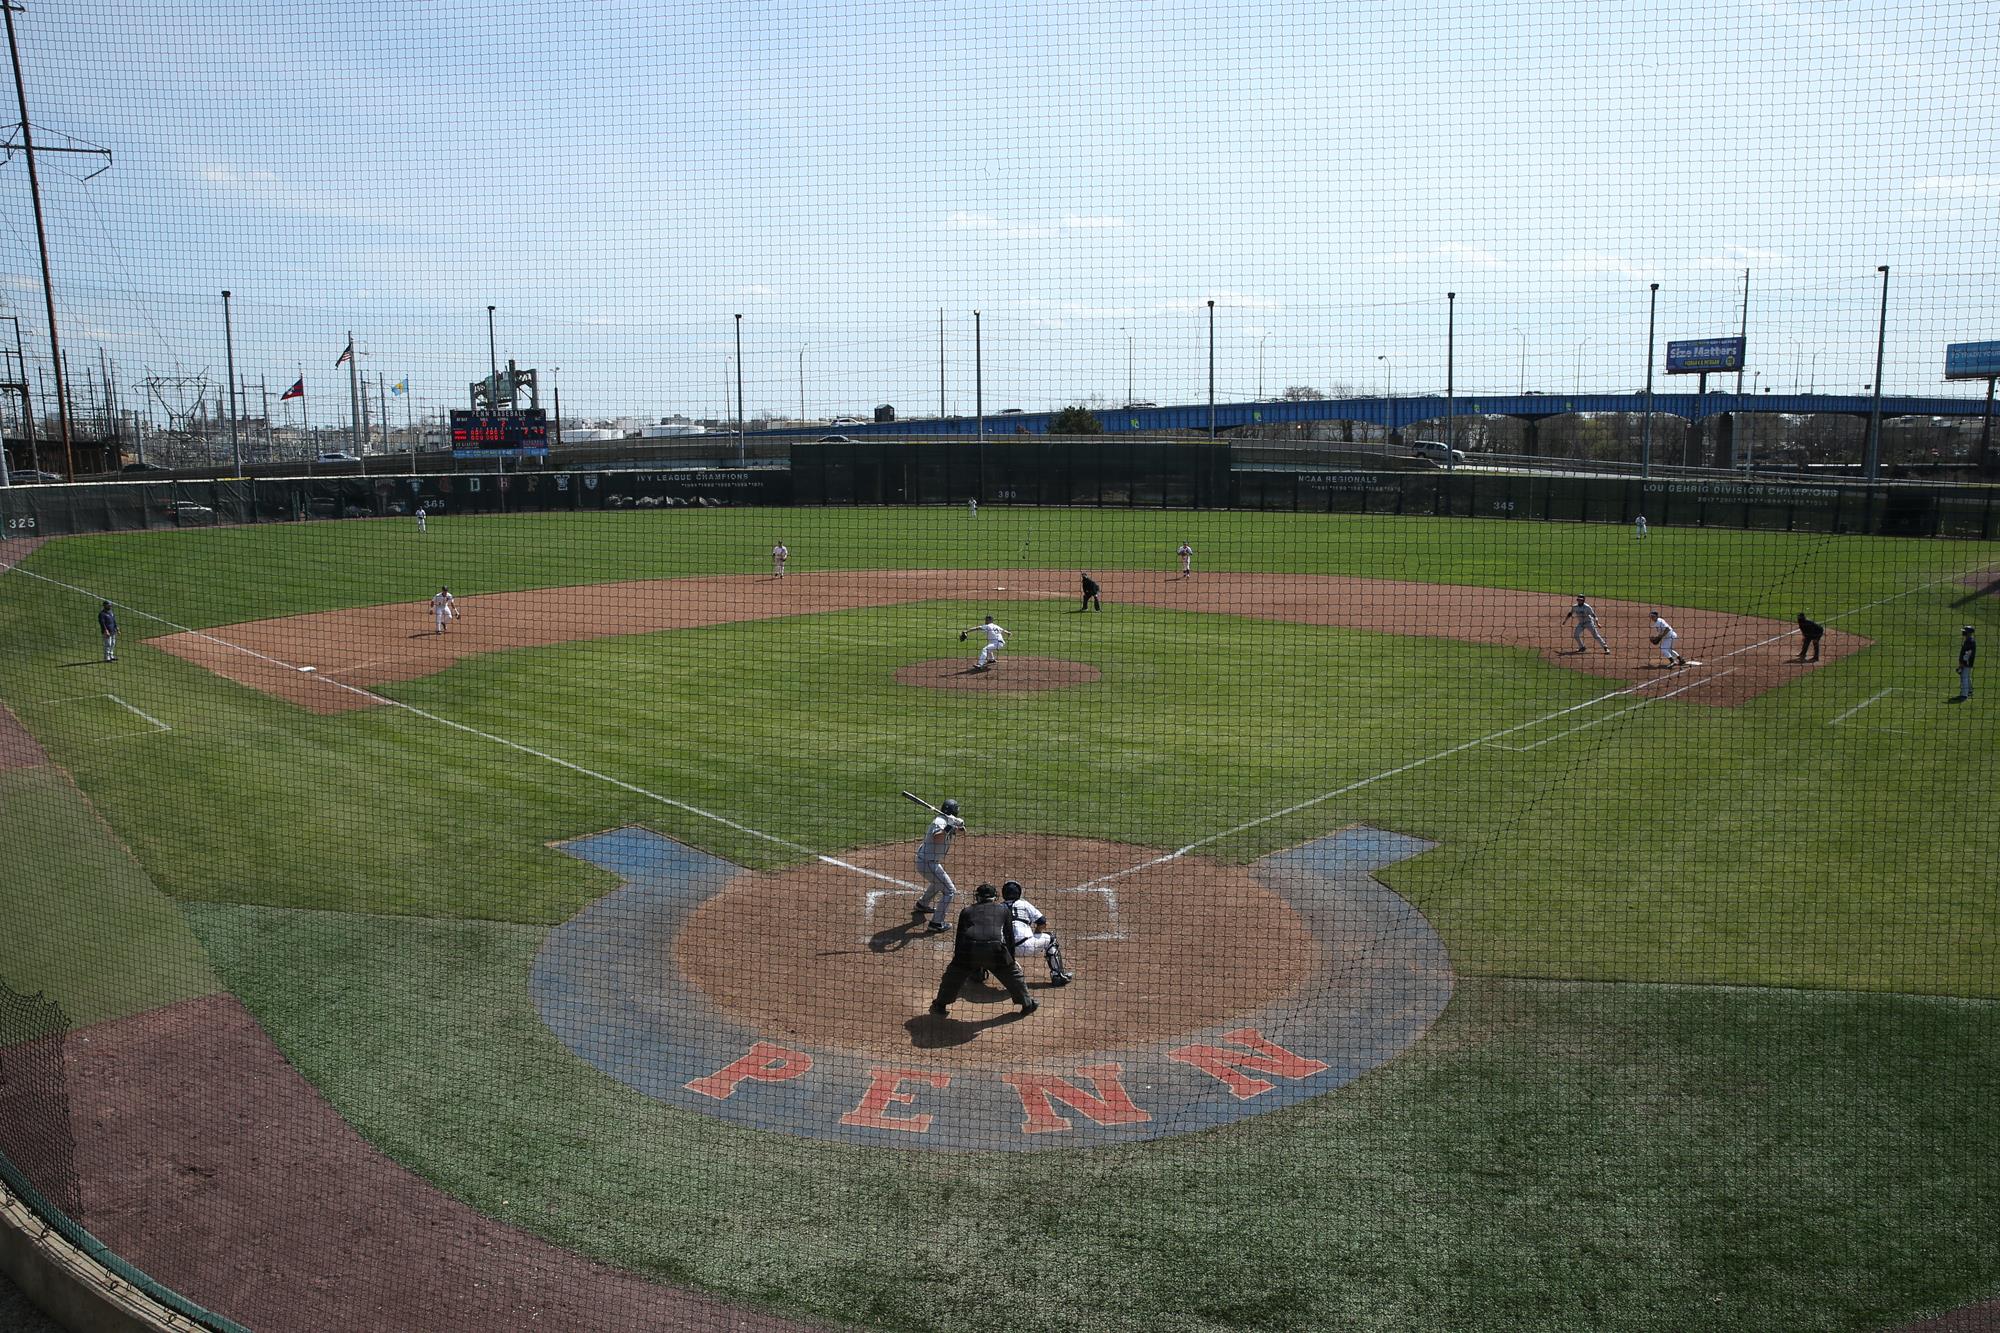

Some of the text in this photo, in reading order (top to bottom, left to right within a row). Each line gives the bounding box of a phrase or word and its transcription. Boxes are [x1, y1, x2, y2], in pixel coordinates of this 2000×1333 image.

[1669, 346, 1737, 358] Size Matters
[471, 410, 490, 418] PENN
[637, 473, 749, 482] IVY LEAGUE CHAMPIONS
[1298, 475, 1377, 484] NCAA REGIONALS
[470, 477, 481, 492] D
[998, 490, 1017, 499] 380
[1643, 484, 1839, 497] LOU GEHRIG DIVISION CHAMPIONS
[423, 500, 445, 509] 365
[1493, 501, 1515, 511] 345
[9, 517, 36, 529] 325
[683, 1028, 1329, 1134] PENN
